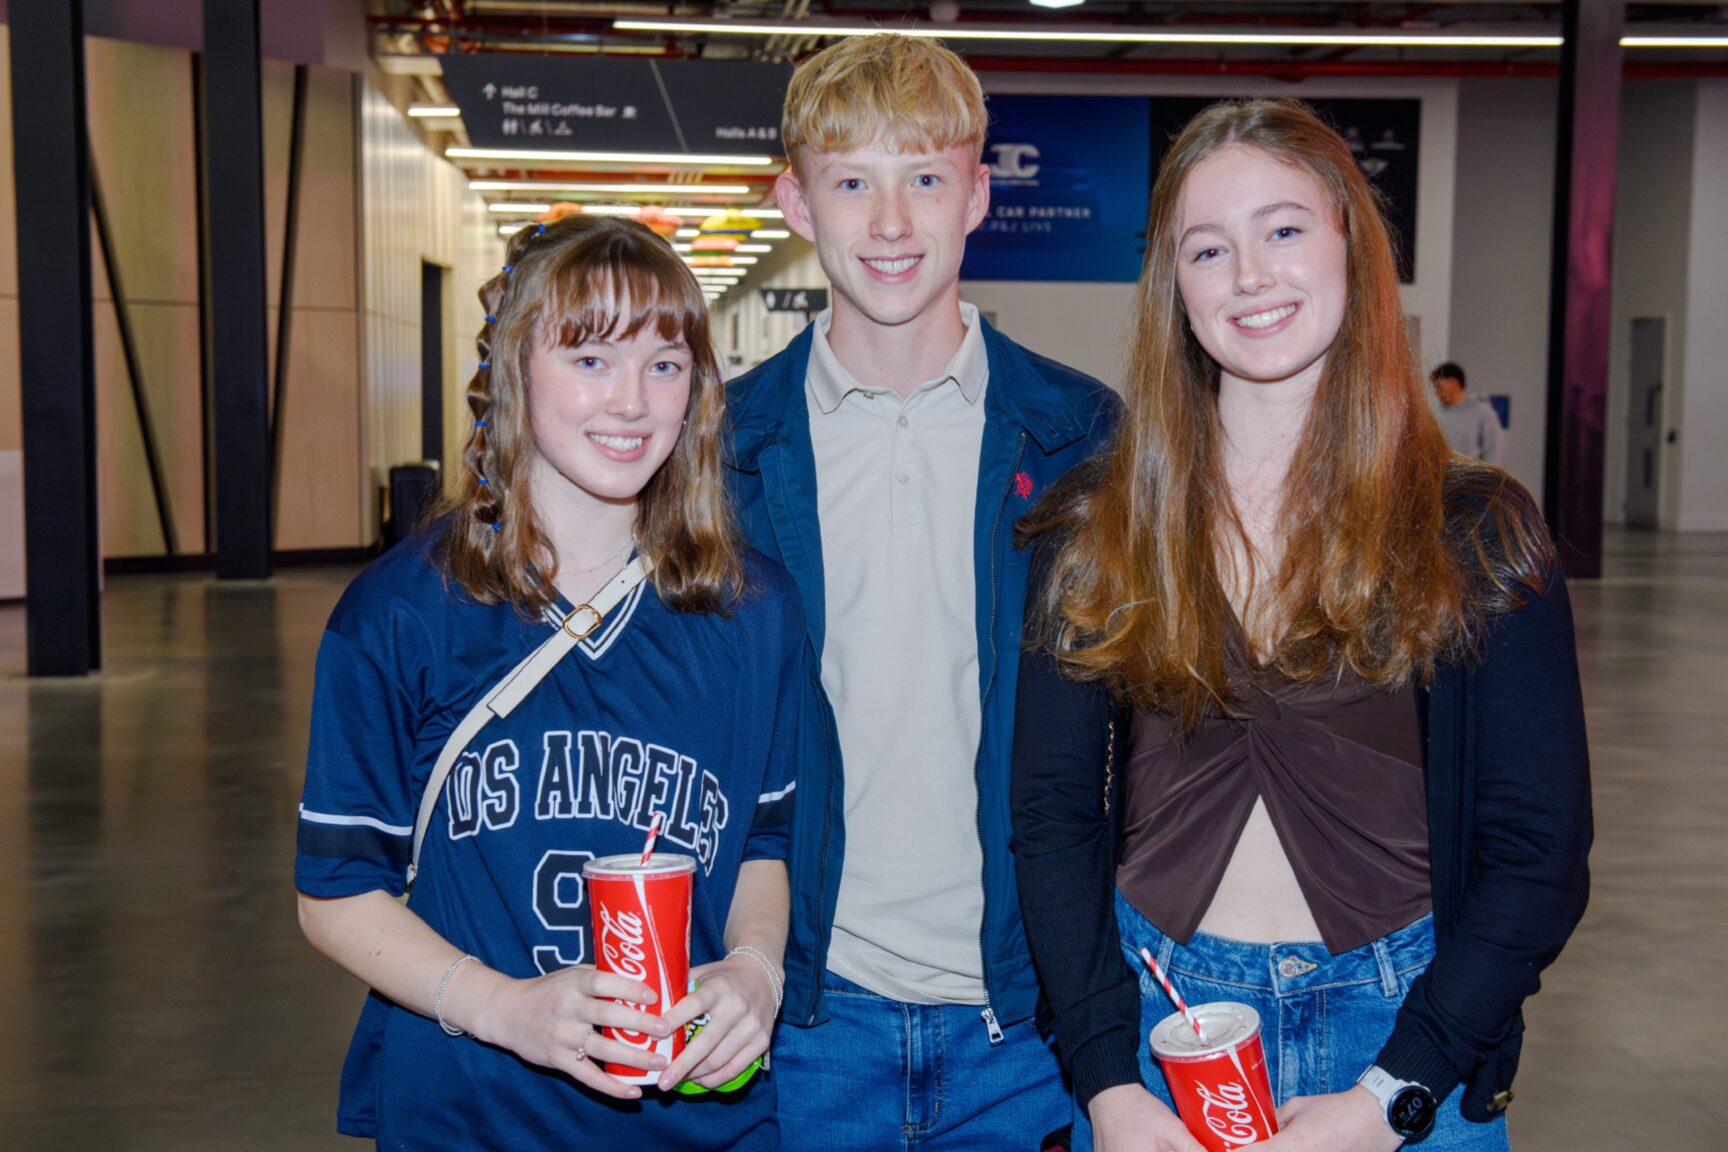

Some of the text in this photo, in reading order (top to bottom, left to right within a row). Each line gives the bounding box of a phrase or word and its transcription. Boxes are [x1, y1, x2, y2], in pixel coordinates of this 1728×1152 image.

[501, 86, 526, 98] Hall
[502, 101, 525, 115] The
[551, 103, 594, 117] Coffee
[595, 104, 617, 117] Bar
[715, 127, 745, 139] Halls
[746, 127, 757, 138] A
[996, 206, 1024, 218] CAR
[1028, 207, 1091, 219] PARTNER
[532, 850, 598, 975] 9
